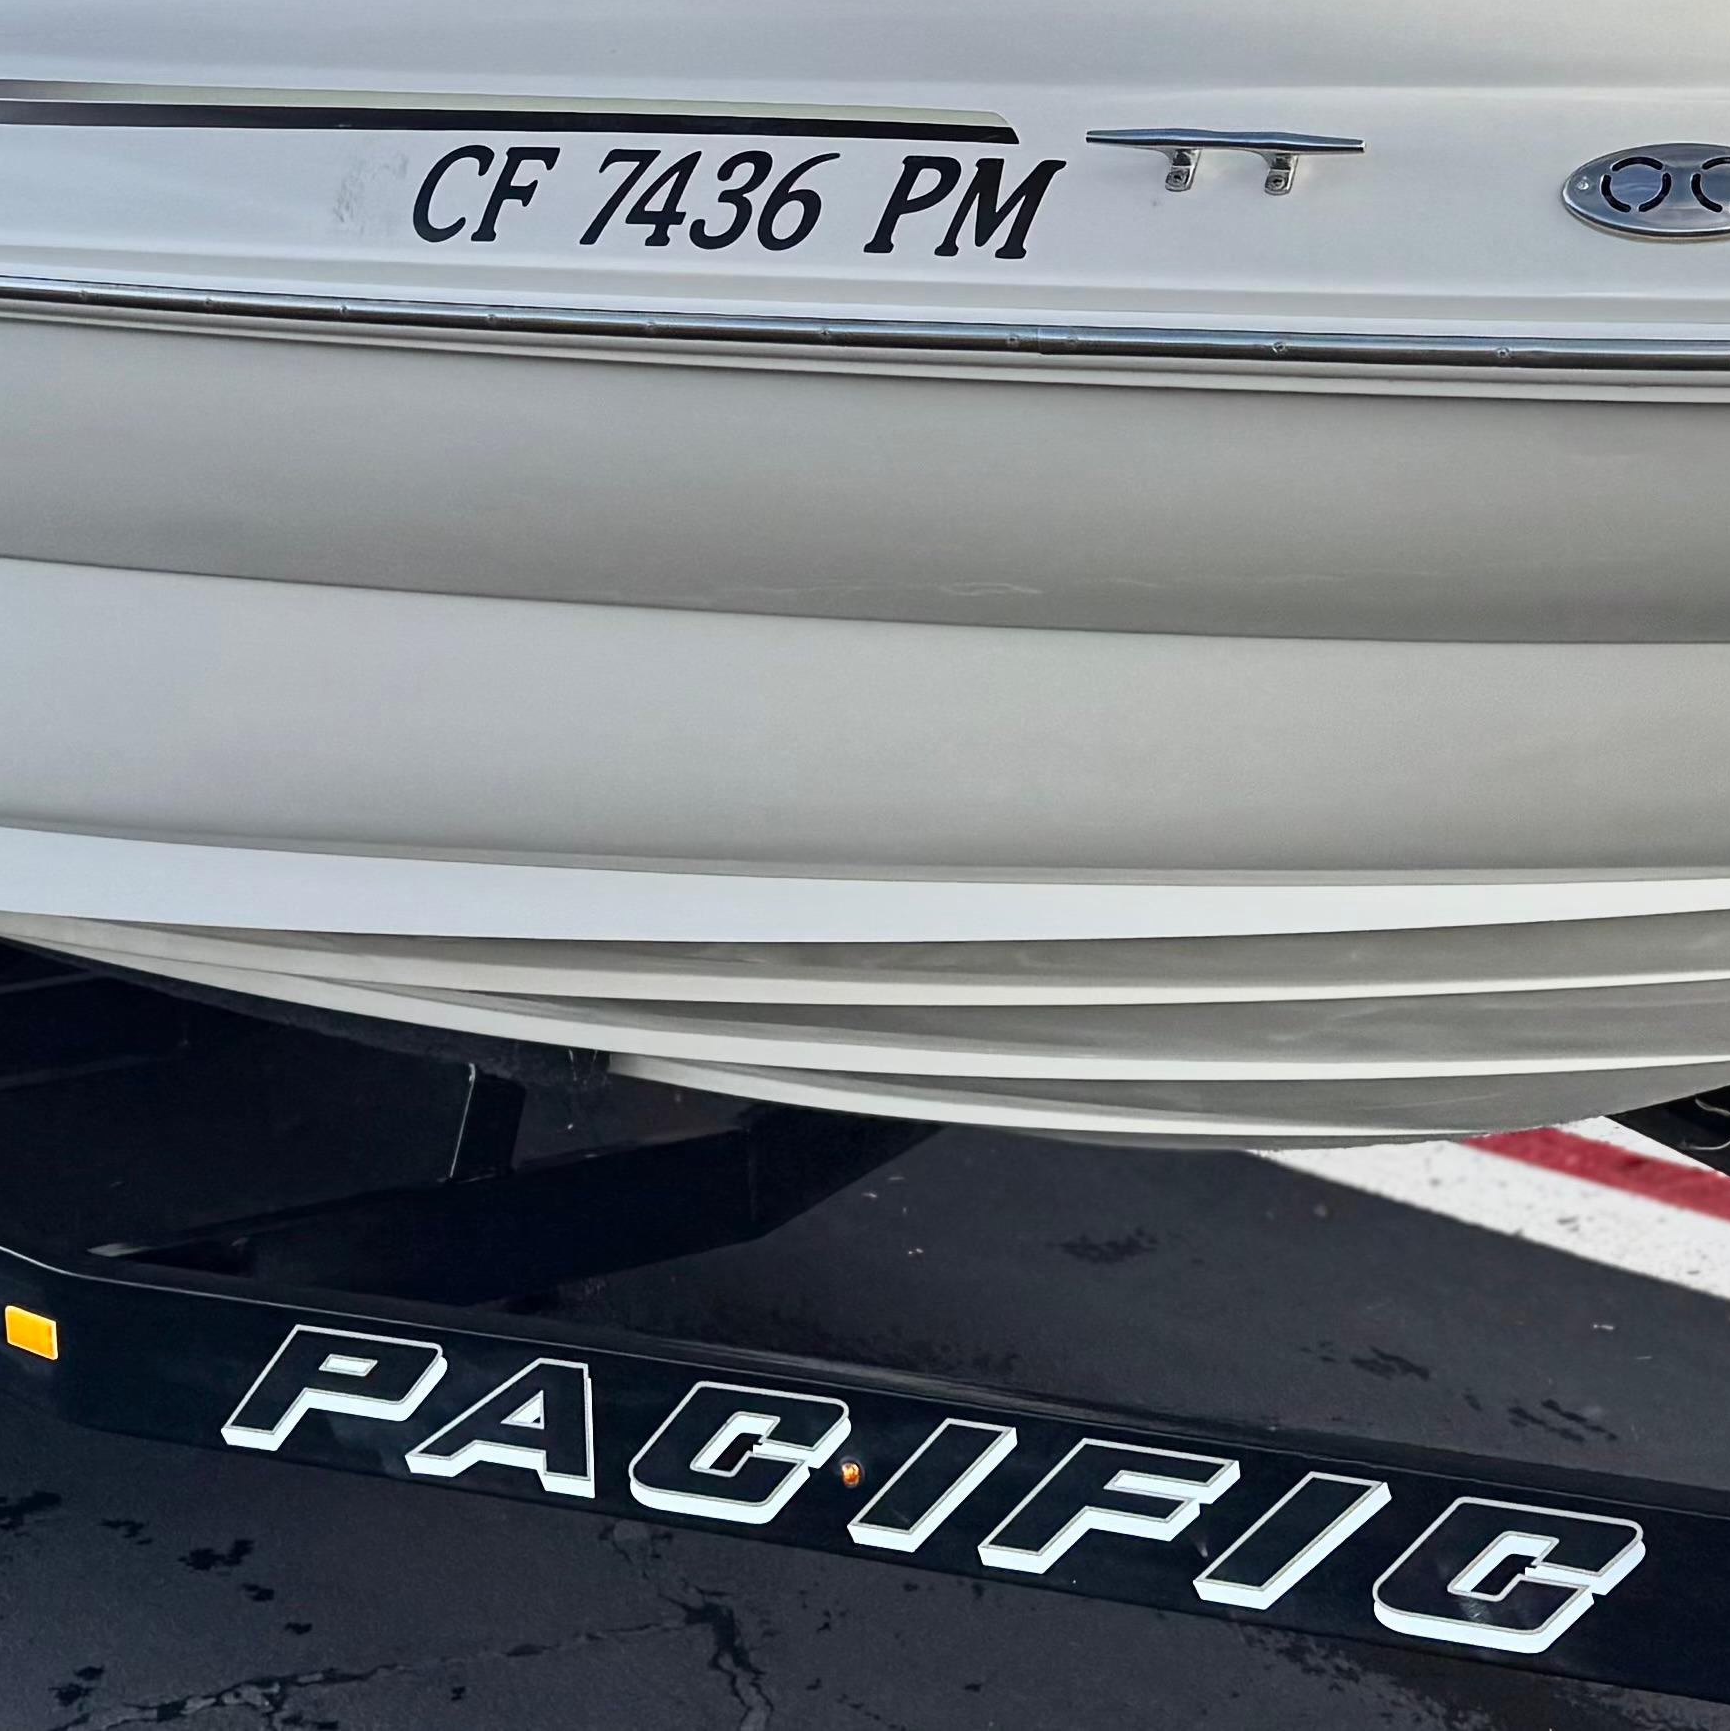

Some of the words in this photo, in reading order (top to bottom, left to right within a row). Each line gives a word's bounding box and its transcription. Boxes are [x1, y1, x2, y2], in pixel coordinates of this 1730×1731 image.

[412, 145, 560, 243] CF
[580, 149, 841, 251] 7436
[863, 155, 1067, 260] PM
[221, 1325, 1646, 1654] PACIFIC
